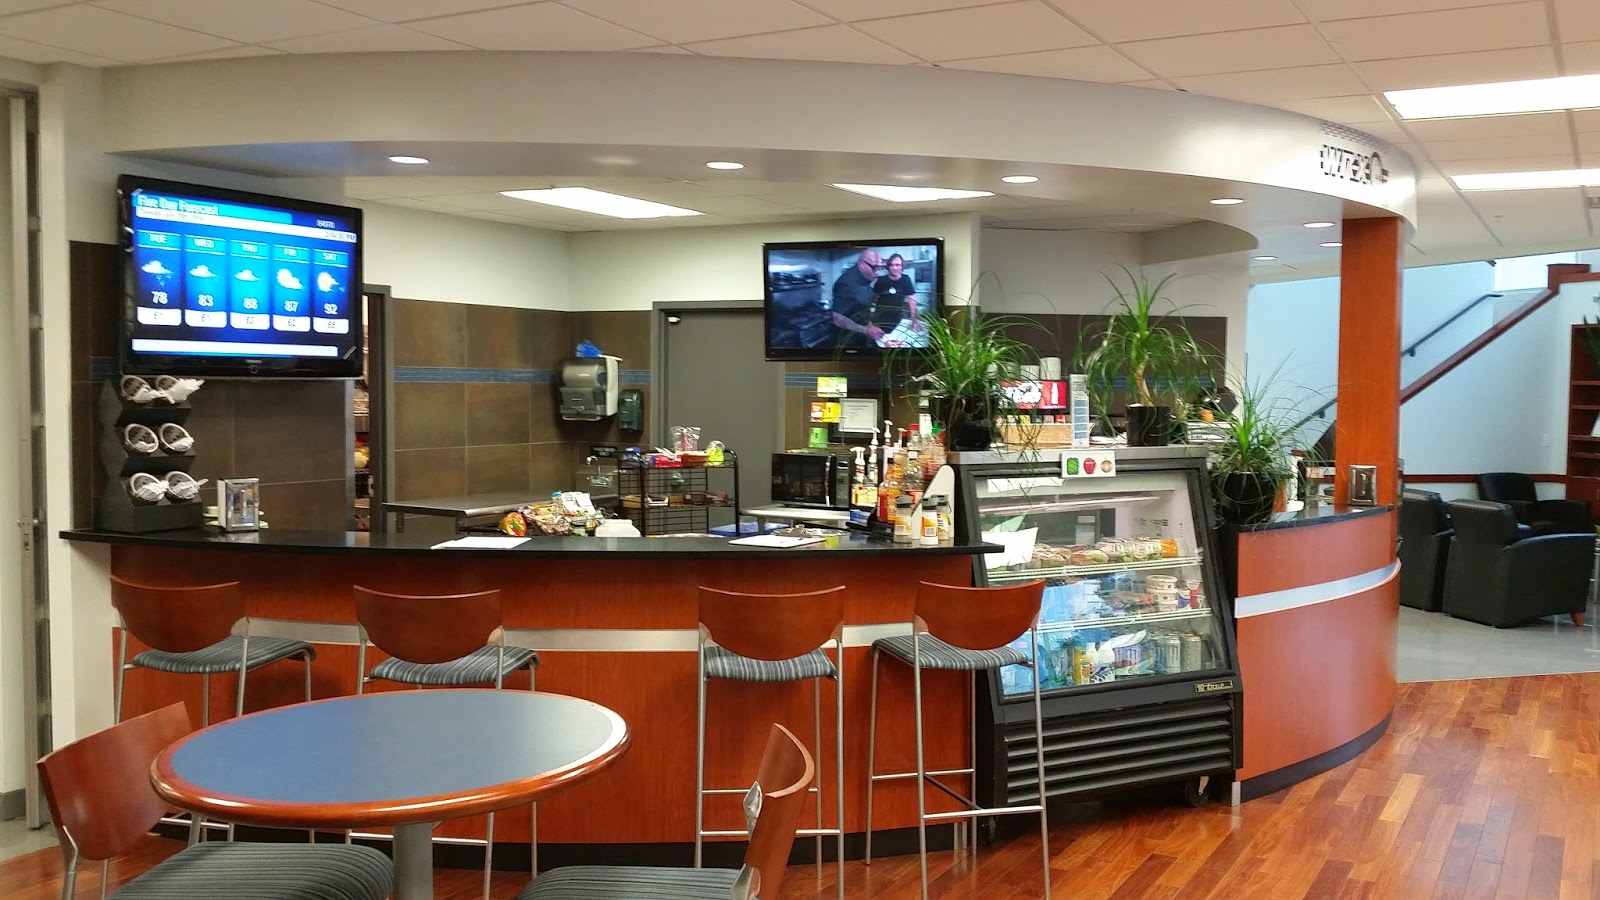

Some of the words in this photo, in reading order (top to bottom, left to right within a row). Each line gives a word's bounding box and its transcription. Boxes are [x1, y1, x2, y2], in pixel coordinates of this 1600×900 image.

[159, 197, 178, 211] Day
[179, 200, 218, 216] Forecast
[149, 234, 167, 244] TUE
[194, 238, 215, 248] WED
[322, 252, 337, 262] SAT
[198, 294, 214, 307] 83
[284, 300, 299, 312] 87
[323, 303, 338, 315] 92
